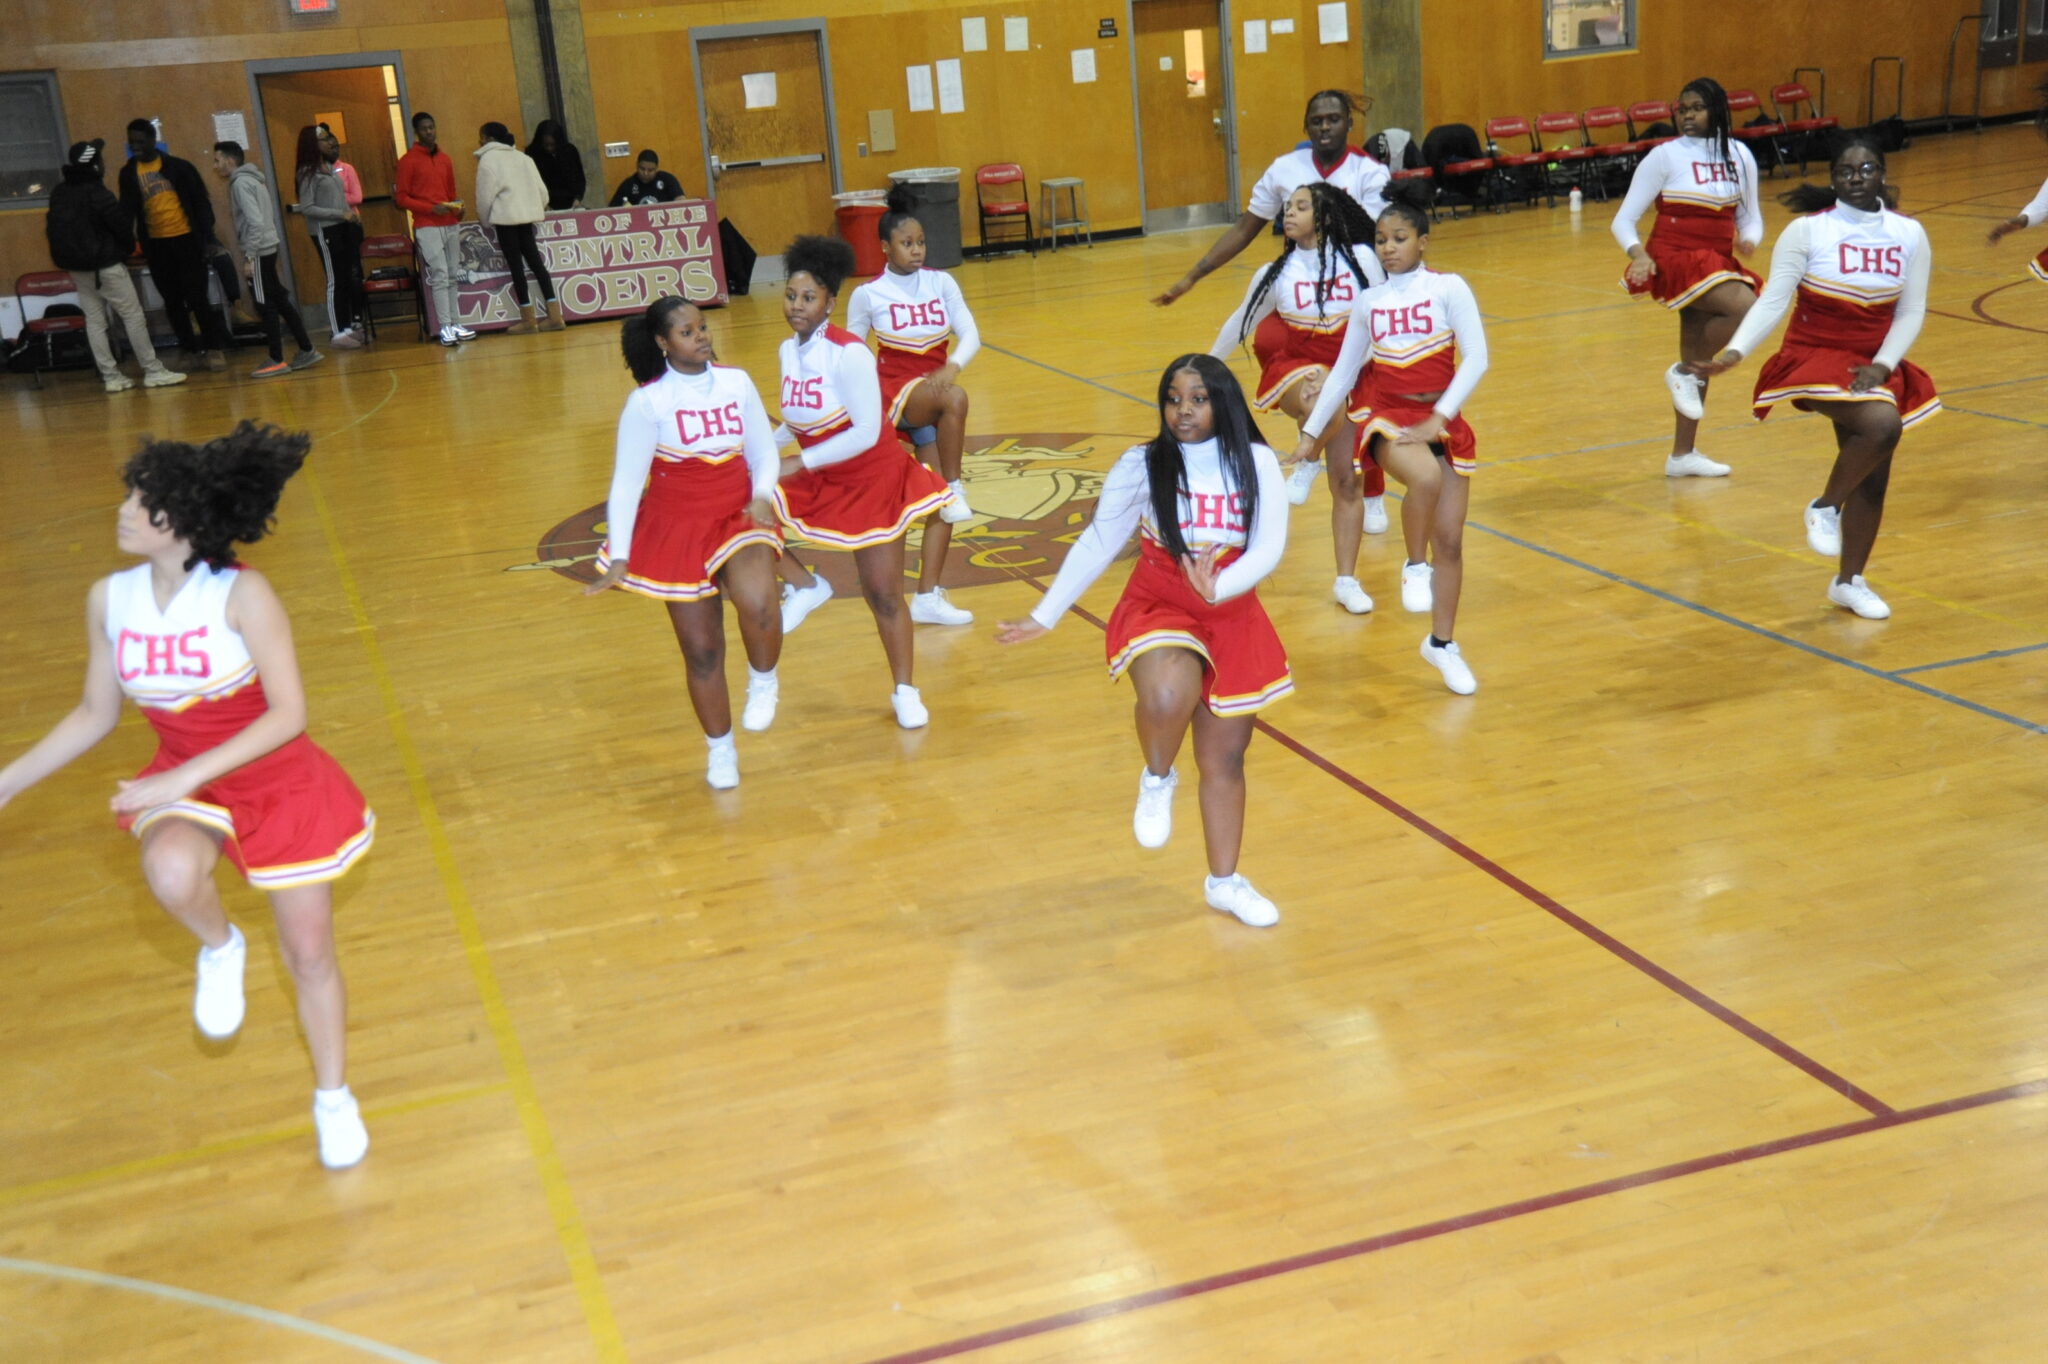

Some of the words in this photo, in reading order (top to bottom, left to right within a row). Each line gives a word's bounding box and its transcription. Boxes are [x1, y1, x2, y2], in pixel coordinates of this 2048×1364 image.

[594, 213, 632, 233] OF
[648, 205, 708, 228] THE
[1838, 243, 1902, 278] CHS
[889, 297, 946, 332] CHS
[1370, 299, 1433, 343] CHS
[780, 375, 823, 410] CHS
[675, 401, 744, 446] CHS
[116, 625, 212, 682] CHS
